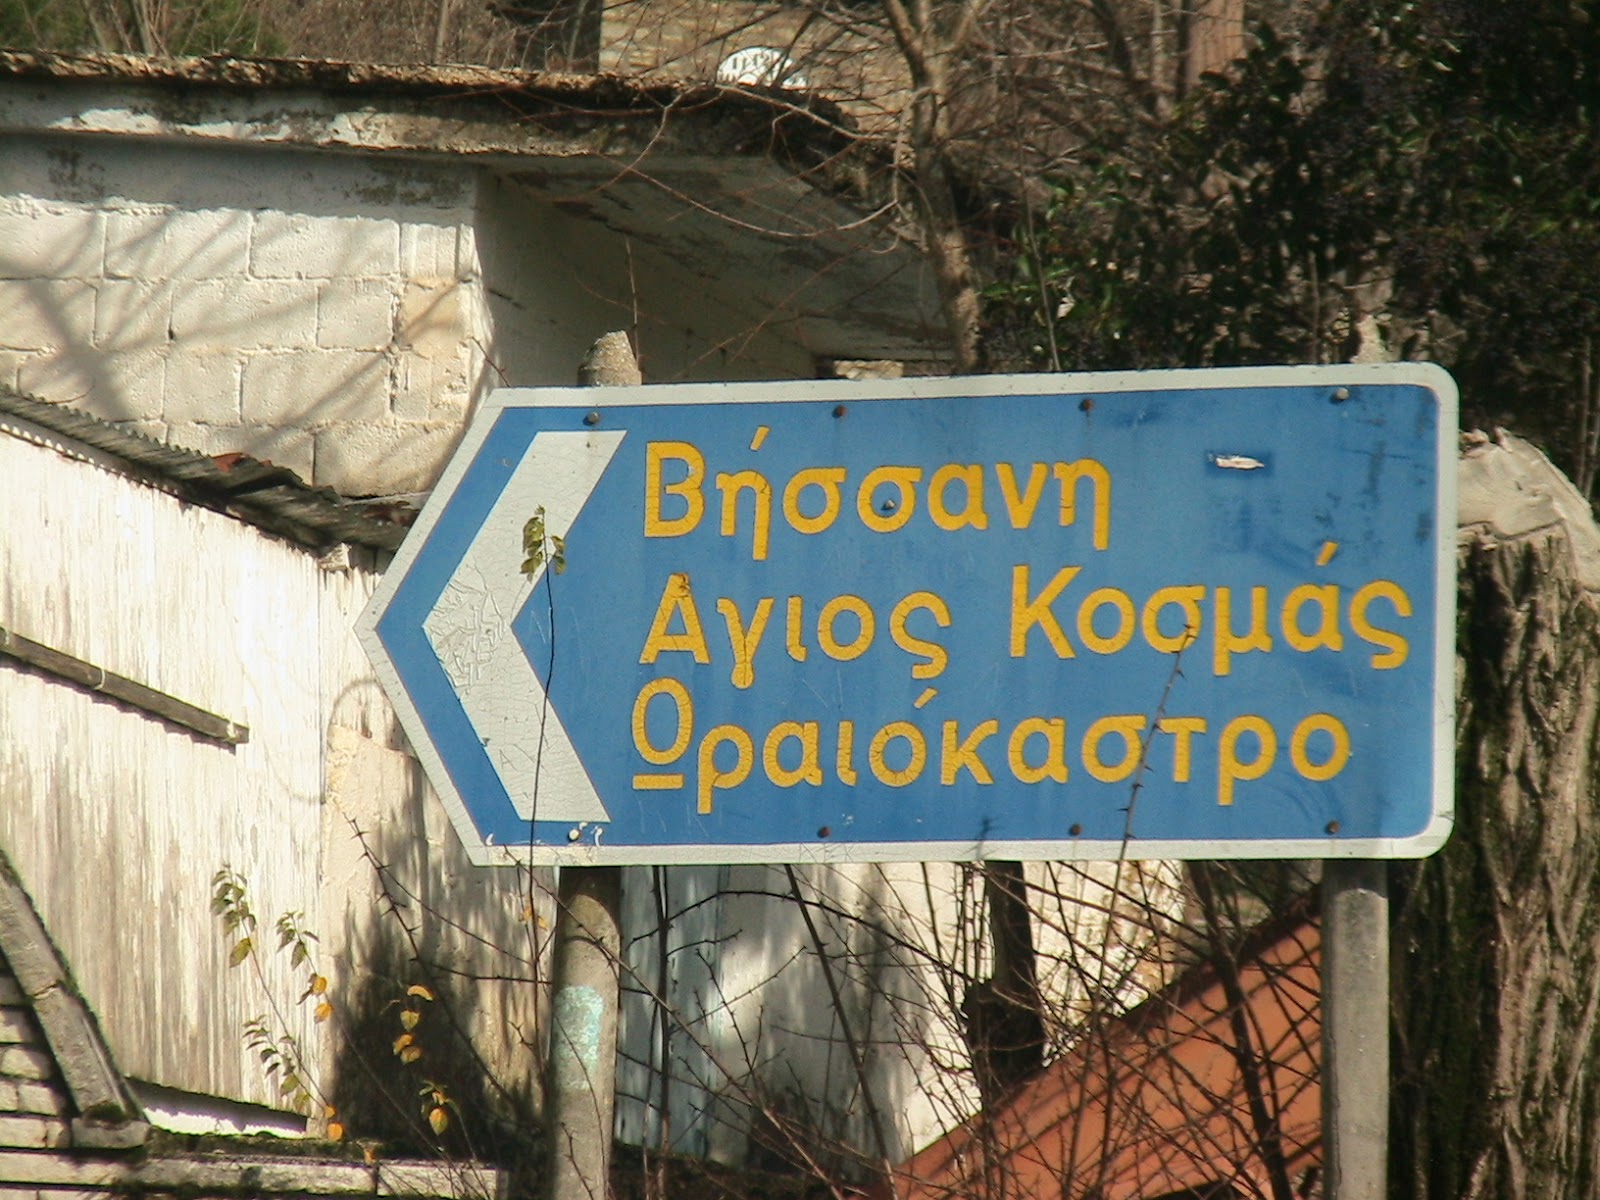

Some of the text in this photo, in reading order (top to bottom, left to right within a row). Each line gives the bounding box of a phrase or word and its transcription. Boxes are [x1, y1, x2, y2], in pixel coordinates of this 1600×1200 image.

[644, 426, 1112, 561] Βήσσανη
[639, 541, 1413, 689] Αγιος Κοσμάς
[632, 677, 1351, 814] Ωραιόκαστρο
